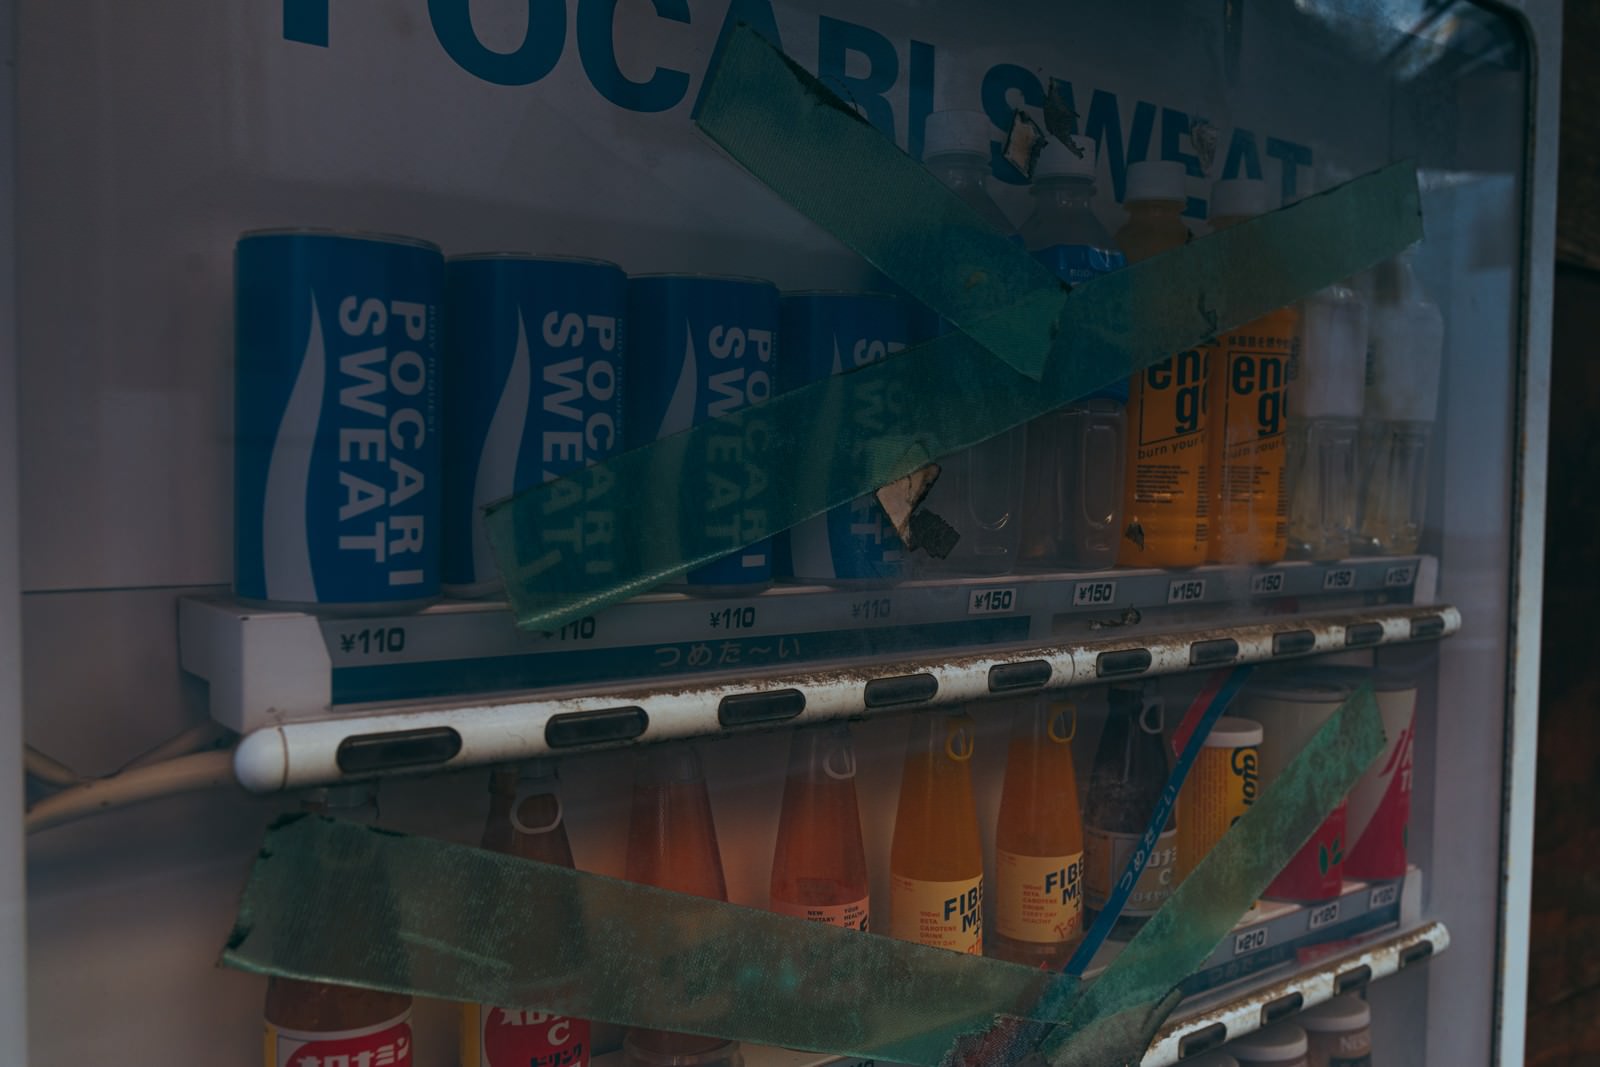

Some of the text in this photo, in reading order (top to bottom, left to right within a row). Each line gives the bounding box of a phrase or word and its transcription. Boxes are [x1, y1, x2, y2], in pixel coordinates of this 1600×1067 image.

[338, 295, 388, 563] SWEAT
[541, 310, 584, 553] SWEAT
[705, 324, 746, 548] SWEAT
[388, 300, 427, 586] POCARI
[584, 314, 617, 575] POCARI
[741, 328, 772, 568] POCARI
[1171, 438, 1198, 456] your
[1079, 583, 1113, 602] ¥150
[1173, 582, 1203, 599] ¥150
[1255, 574, 1282, 591] ¥150
[852, 599, 891, 619] ¥110
[974, 590, 1012, 611] ¥150
[710, 606, 756, 629] ¥110
[340, 627, 405, 654] ¥110
[1238, 930, 1265, 946] ¥210
[547, 1019, 570, 1046] C
